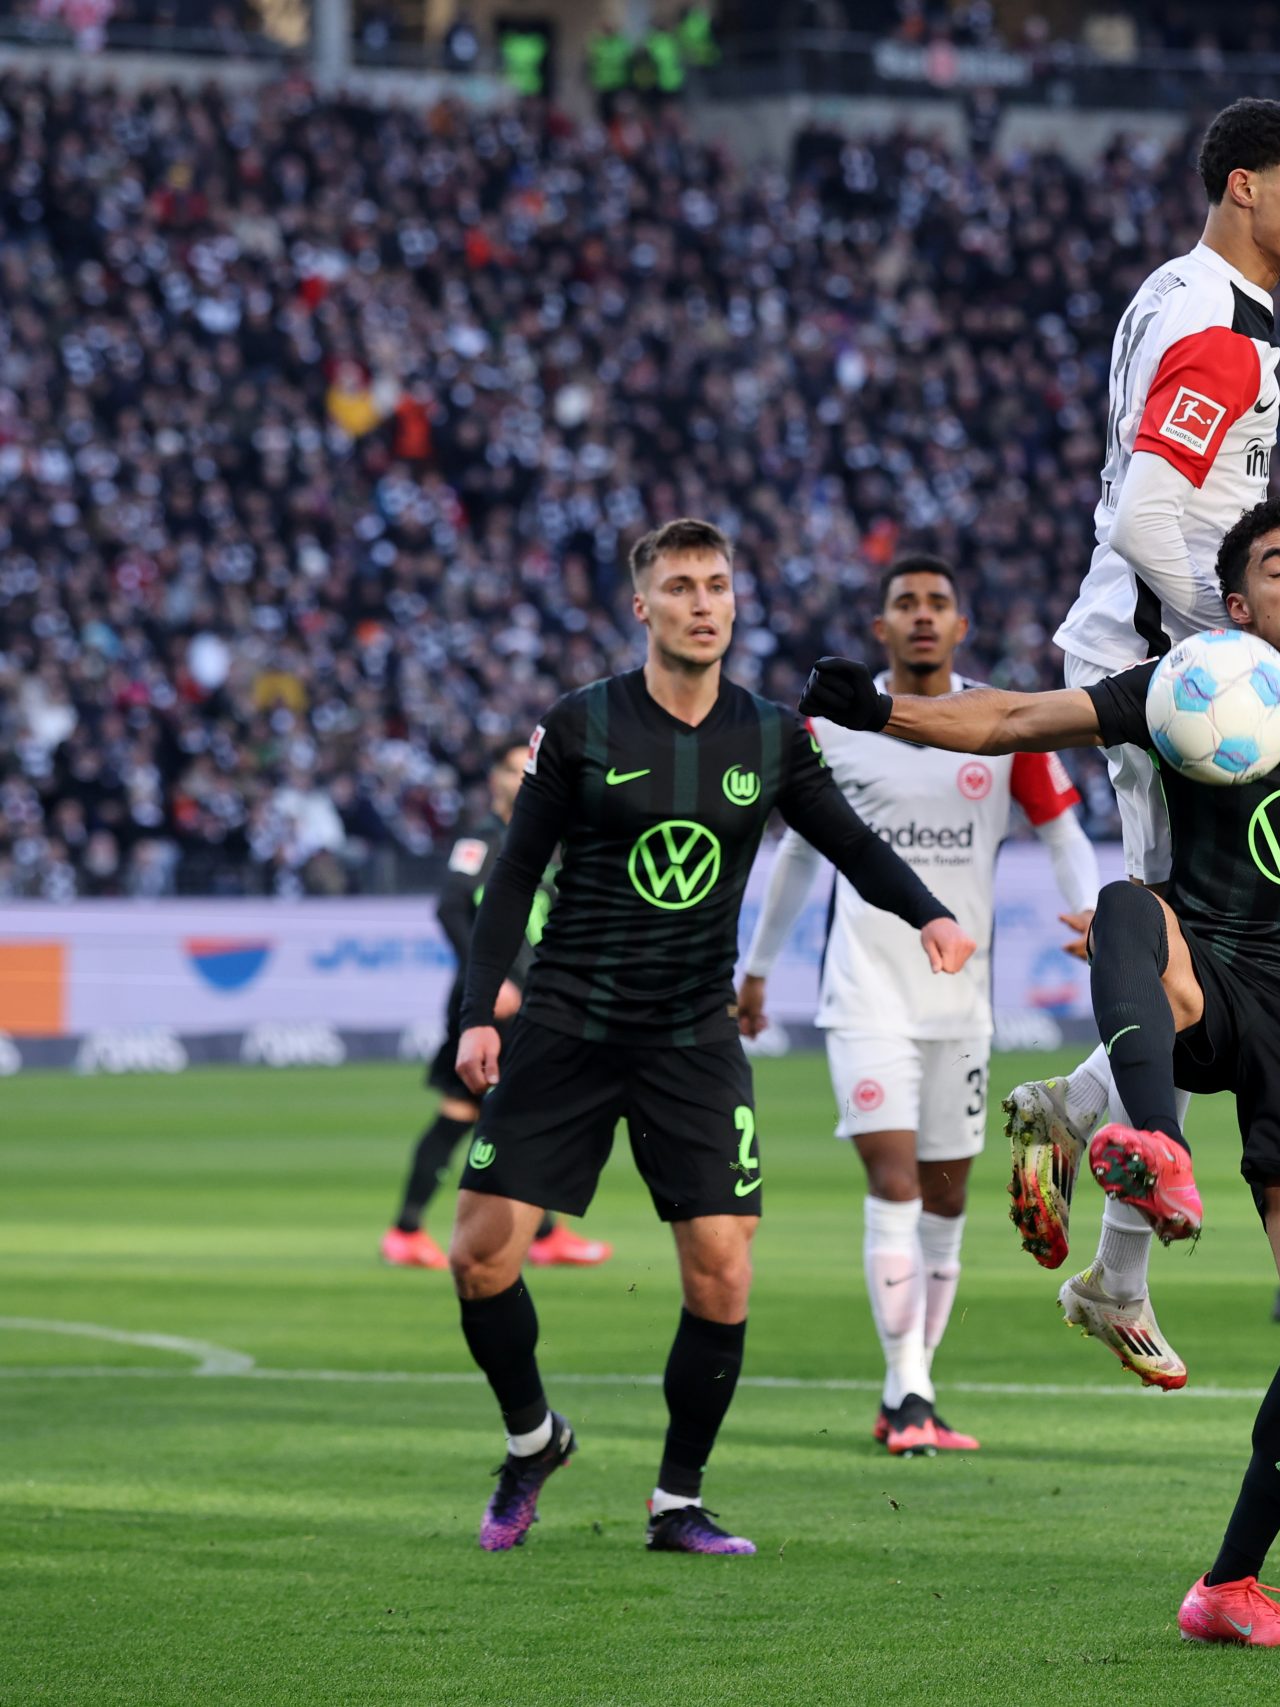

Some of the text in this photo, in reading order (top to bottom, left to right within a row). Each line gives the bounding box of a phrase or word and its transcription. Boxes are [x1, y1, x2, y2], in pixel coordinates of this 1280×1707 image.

[1165, 426, 1203, 450] BUNDESLIGA
[874, 820, 974, 849] ndeed
[734, 1106, 759, 1168] 2
